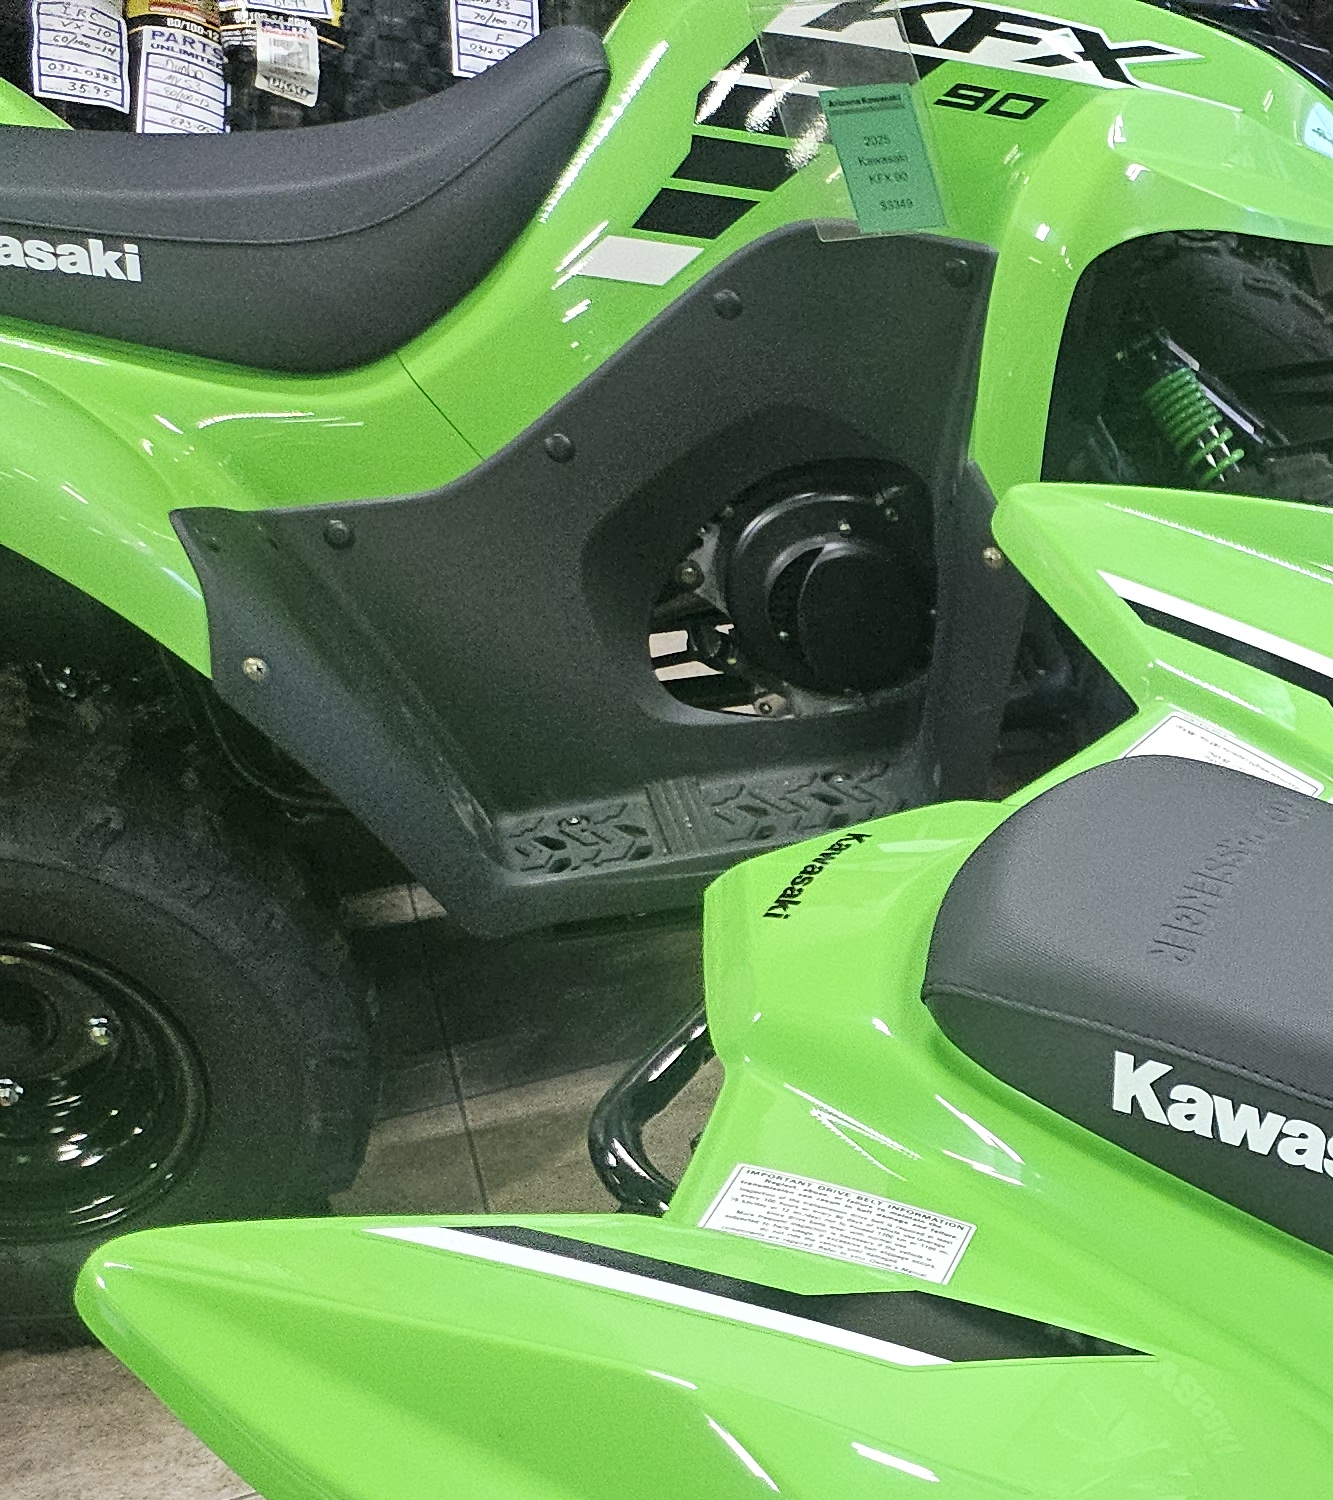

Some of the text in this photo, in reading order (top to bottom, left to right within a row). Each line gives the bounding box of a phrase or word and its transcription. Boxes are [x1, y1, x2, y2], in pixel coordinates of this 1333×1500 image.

[150, 29, 226, 61] PARTS
[934, 82, 1050, 121] 90
[857, 154, 909, 167] Kawasaki
[862, 135, 891, 148] 2025
[0, 236, 142, 282] asaki
[763, 832, 873, 919] Kawasaki
[746, 1169, 965, 1230] IMPORTANT DRIVE BELT INFORMATION
